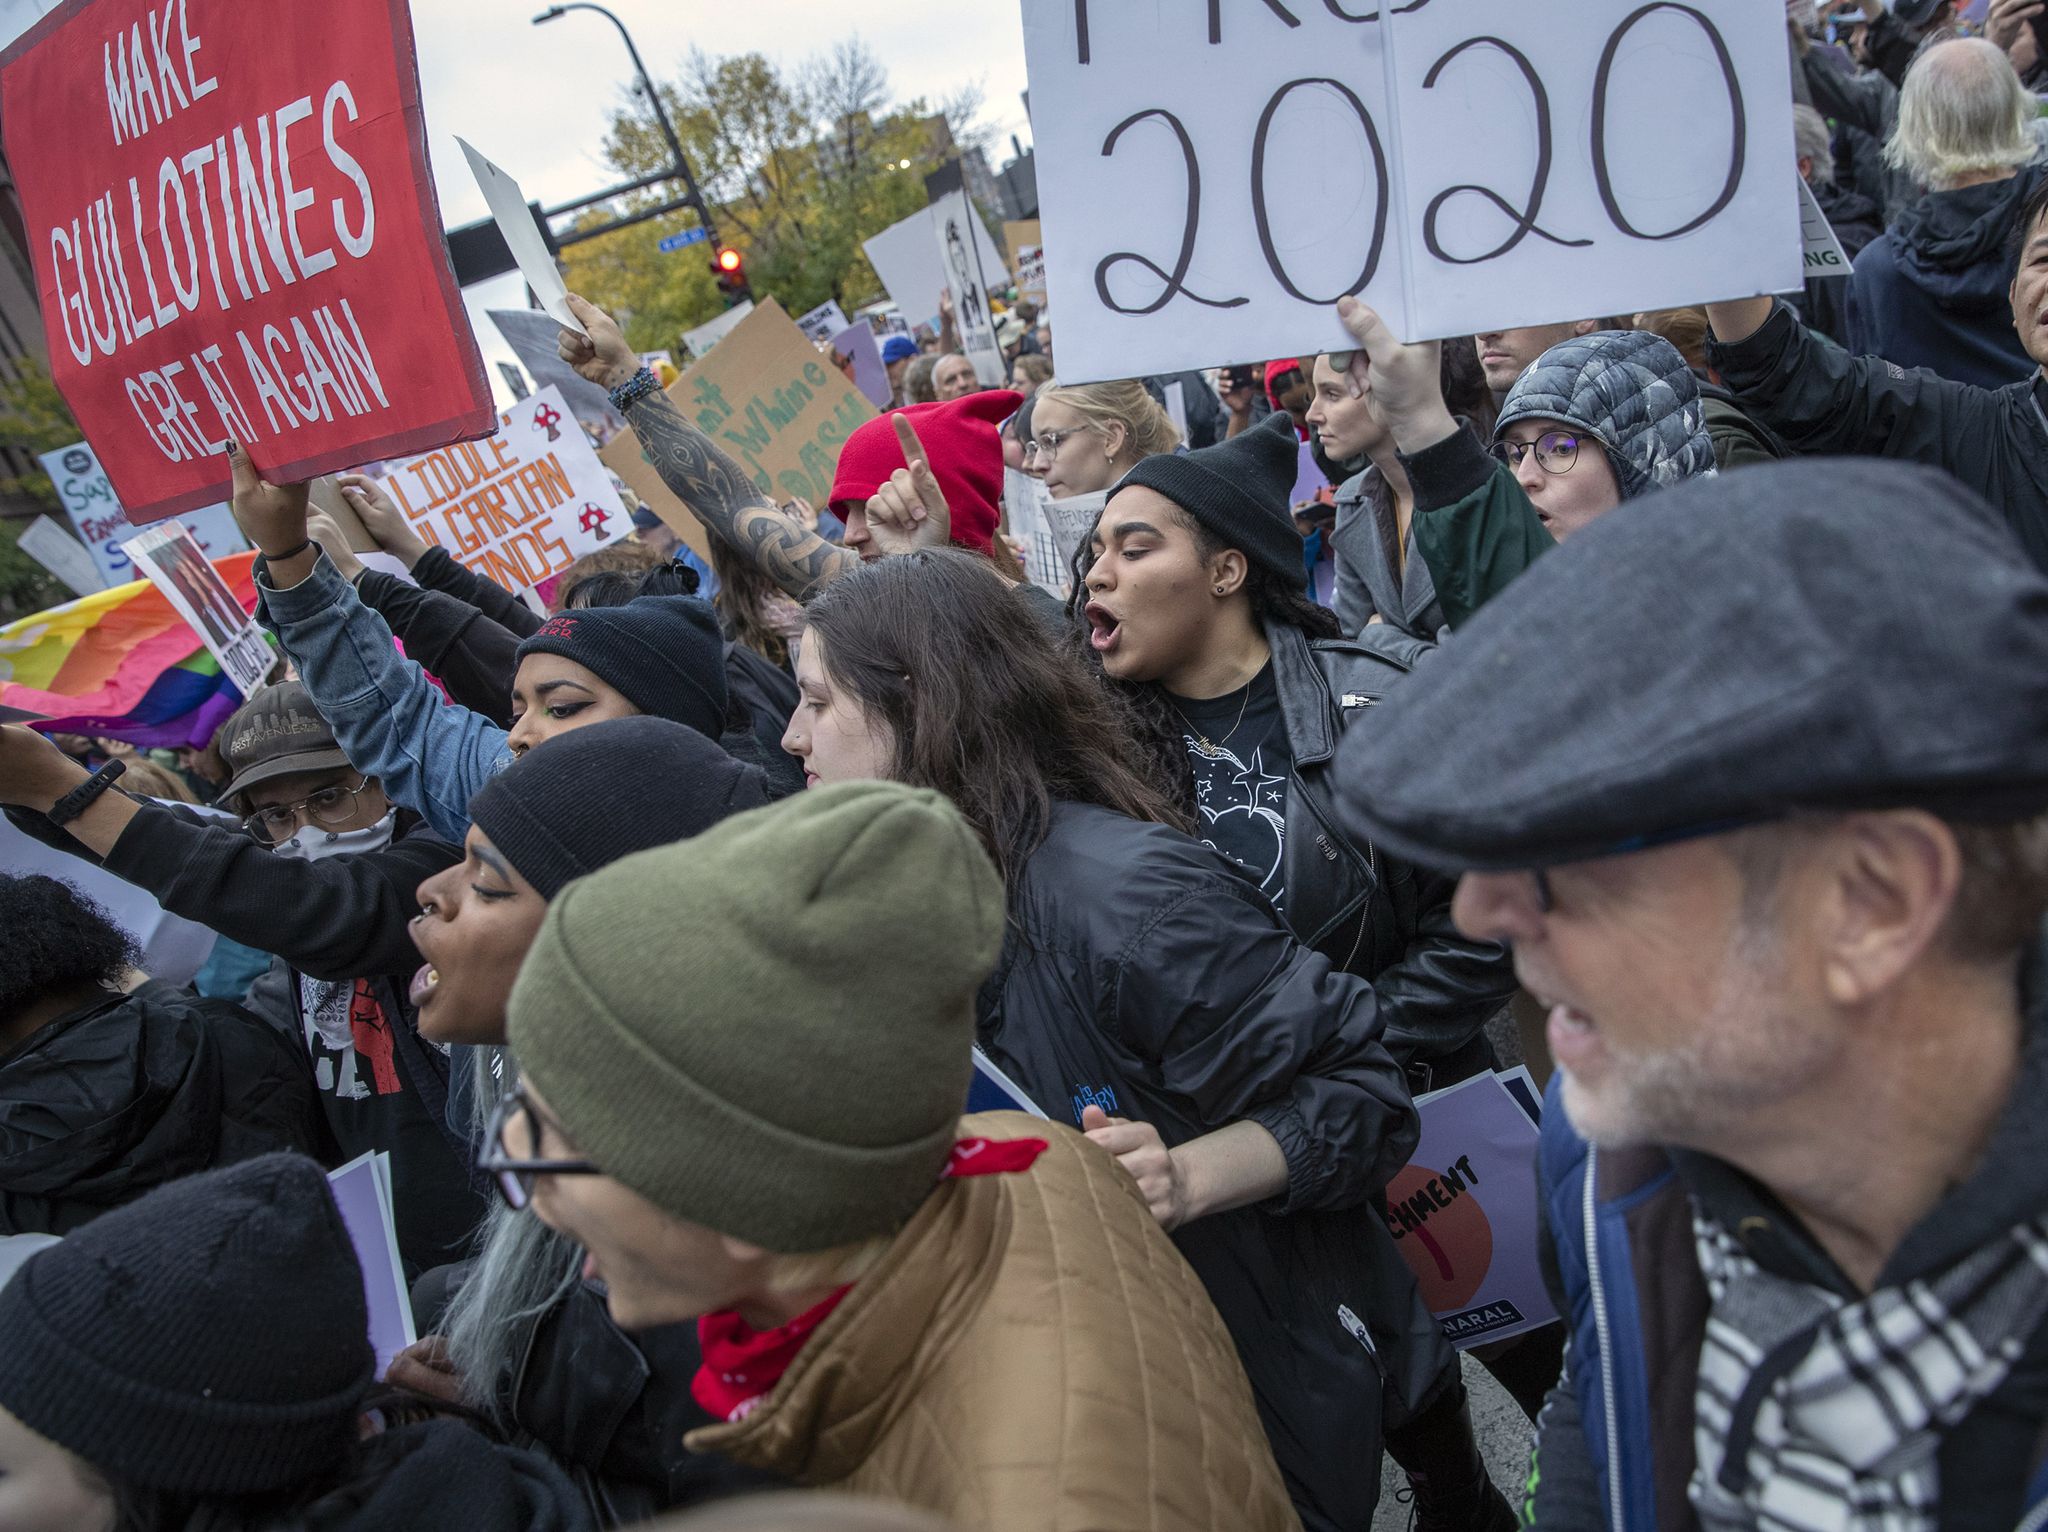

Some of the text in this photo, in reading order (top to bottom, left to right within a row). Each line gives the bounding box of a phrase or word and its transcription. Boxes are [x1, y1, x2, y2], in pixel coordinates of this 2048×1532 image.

[104, 0, 218, 146] MAKE
[51, 80, 376, 367] GUILLOTINES
[1095, 1, 1746, 315] 2020
[125, 299, 390, 464] GREAT AGAIN
[252, 723, 302, 745] AVENUE
[1442, 1305, 1513, 1335] NARAL
